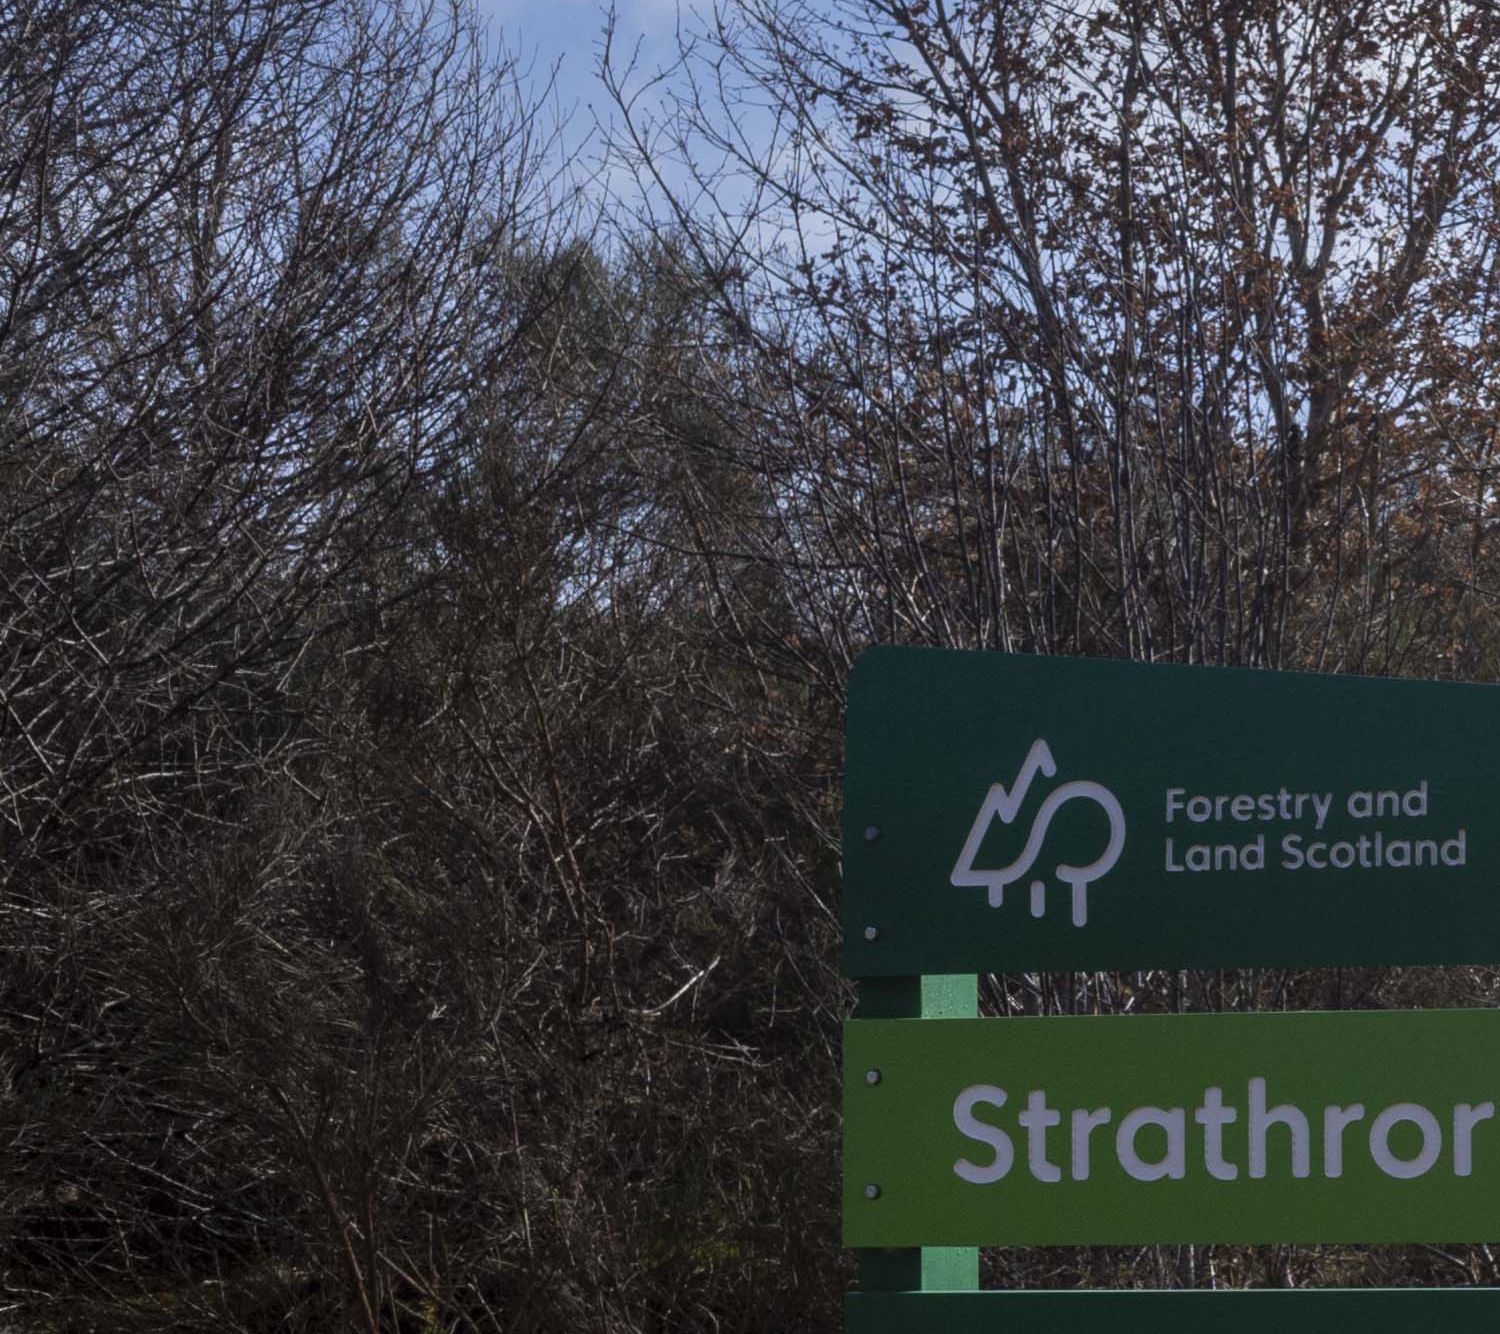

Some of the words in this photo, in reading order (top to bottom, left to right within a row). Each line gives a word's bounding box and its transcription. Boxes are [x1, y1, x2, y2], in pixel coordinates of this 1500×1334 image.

[1166, 786, 1333, 828] Forestry
[1348, 781, 1428, 819] and
[1166, 834, 1265, 872] Land
[1281, 823, 1467, 870] Scotland
